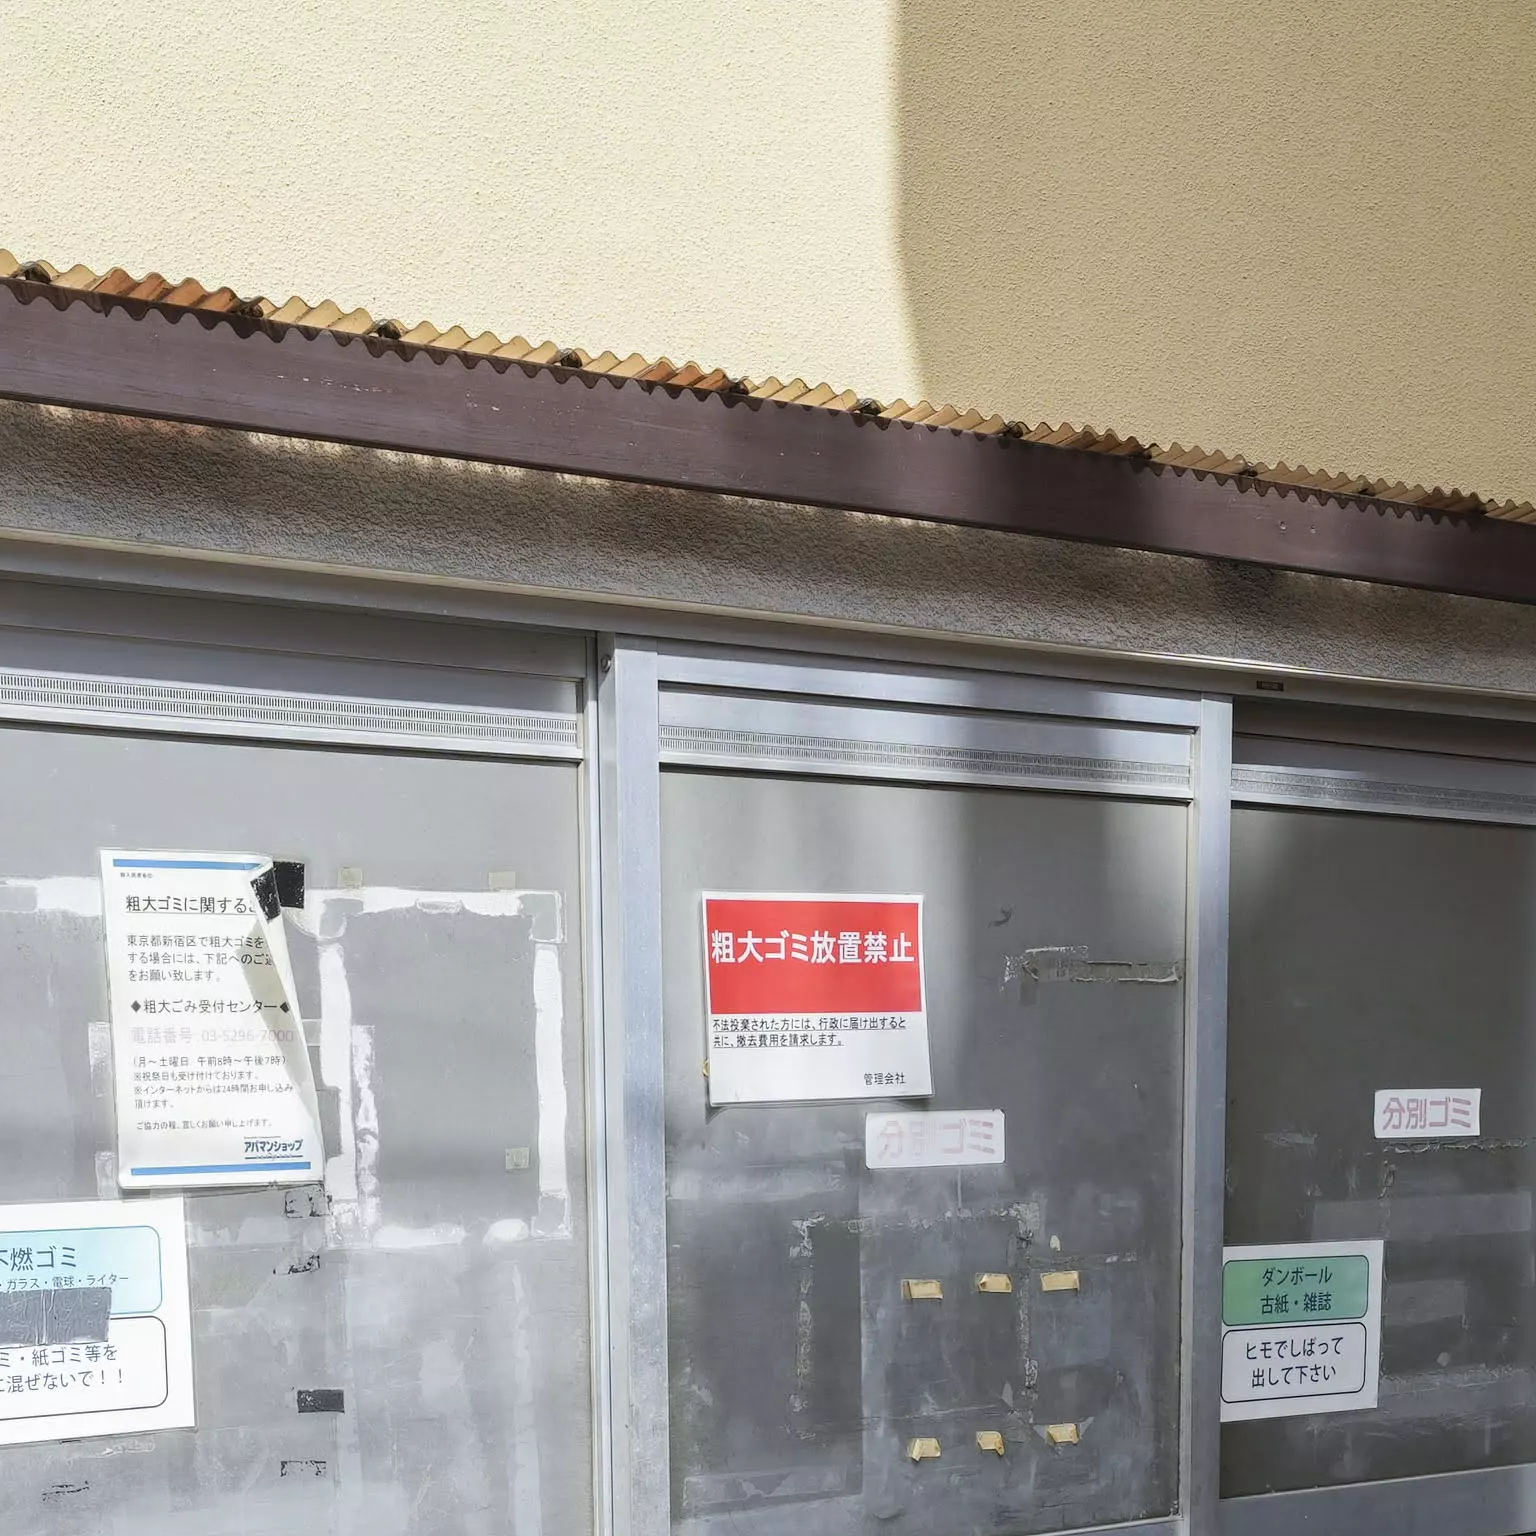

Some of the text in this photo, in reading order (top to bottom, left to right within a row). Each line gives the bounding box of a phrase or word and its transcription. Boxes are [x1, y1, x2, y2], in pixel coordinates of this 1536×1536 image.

[127, 934, 265, 949] 東京都新宿区で粗大ゴミを
[711, 929, 914, 964] 粗大ゴミ放置禁止
[128, 968, 221, 983] をお願い致します。
[144, 998, 277, 1014] 粗大ごみ受付センター
[713, 1016, 906, 1030] 不法投棄された方には、行政に届け出すると
[713, 1033, 843, 1047] 共に、撤去費用を請求します。
[864, 1072, 906, 1086] 管理会社
[1383, 1096, 1471, 1130] 分別ゴミ
[244, 1138, 304, 1154] アパマンショップ
[1262, 1265, 1333, 1288] ダンボール
[1260, 1291, 1332, 1315] 古紙・雑誌
[1246, 1336, 1344, 1361] ヒモでしばって
[1251, 1363, 1337, 1389] 出して下さい
